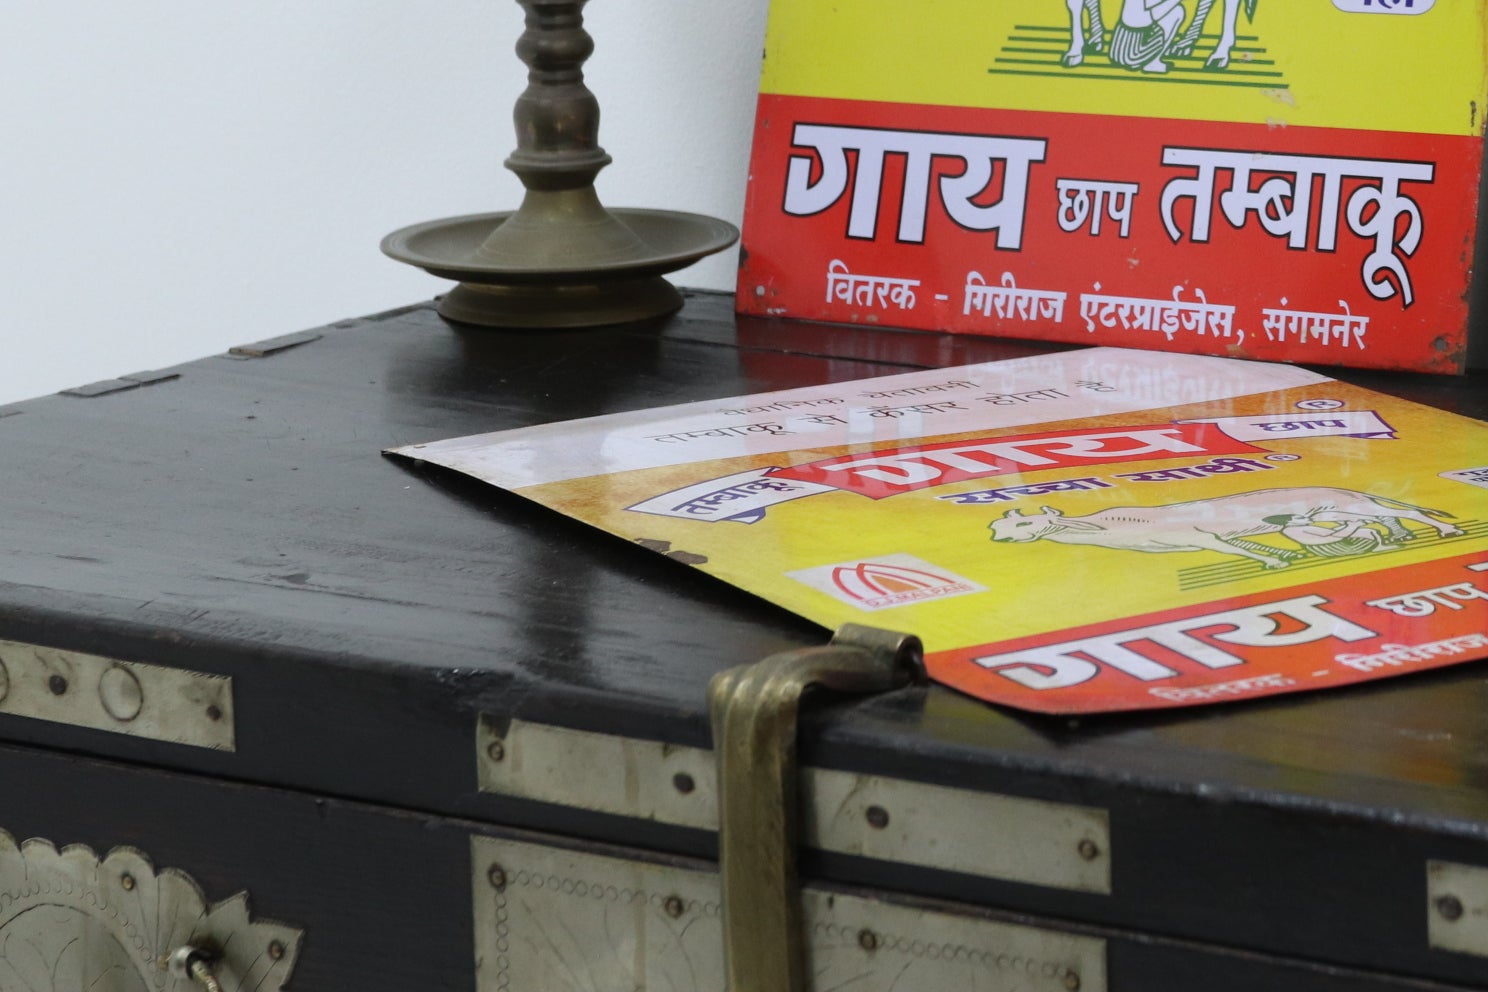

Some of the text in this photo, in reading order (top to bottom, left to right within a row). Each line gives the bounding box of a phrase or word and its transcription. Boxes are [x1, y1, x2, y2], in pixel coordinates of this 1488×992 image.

[784, 122, 1435, 309] गाय छाप तम्बाकू
[826, 259, 920, 309] वितरक
[963, 270, 1067, 323] गिरीराज
[1262, 296, 1370, 350] संगमनेर
[970, 594, 1380, 690] गाय
